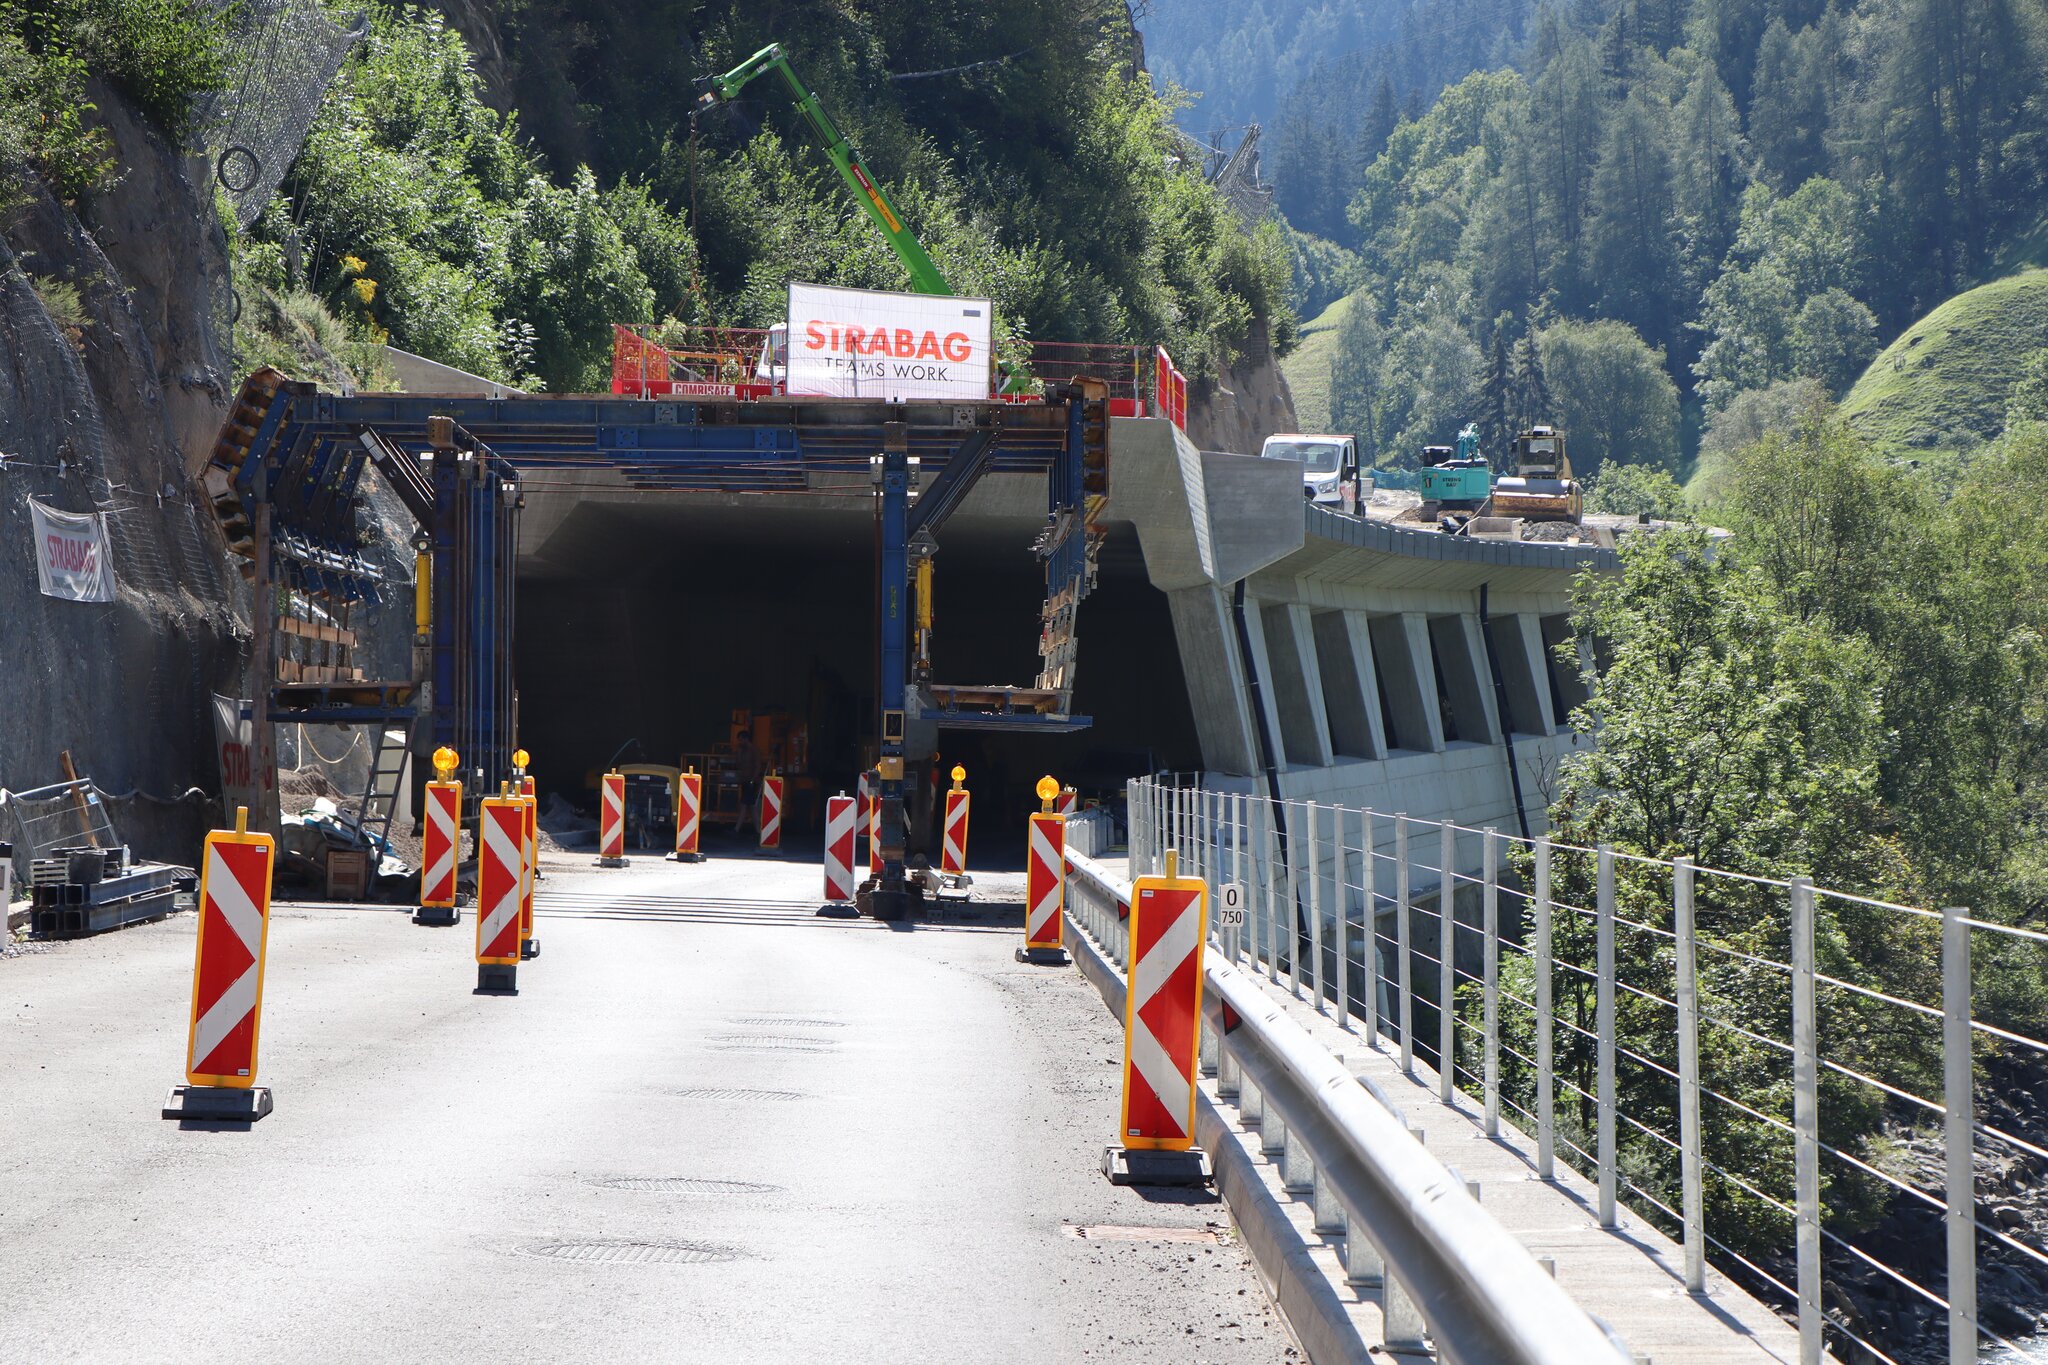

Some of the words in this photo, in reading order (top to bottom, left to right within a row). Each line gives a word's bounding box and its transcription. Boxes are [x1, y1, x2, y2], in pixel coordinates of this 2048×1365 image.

[805, 320, 972, 363] STRABAG
[825, 357, 885, 377] TEAMS
[893, 363, 953, 382] WORK.
[47, 534, 96, 574] STRABAG
[1226, 889, 1238, 906] 0
[1222, 911, 1242, 924] 750
